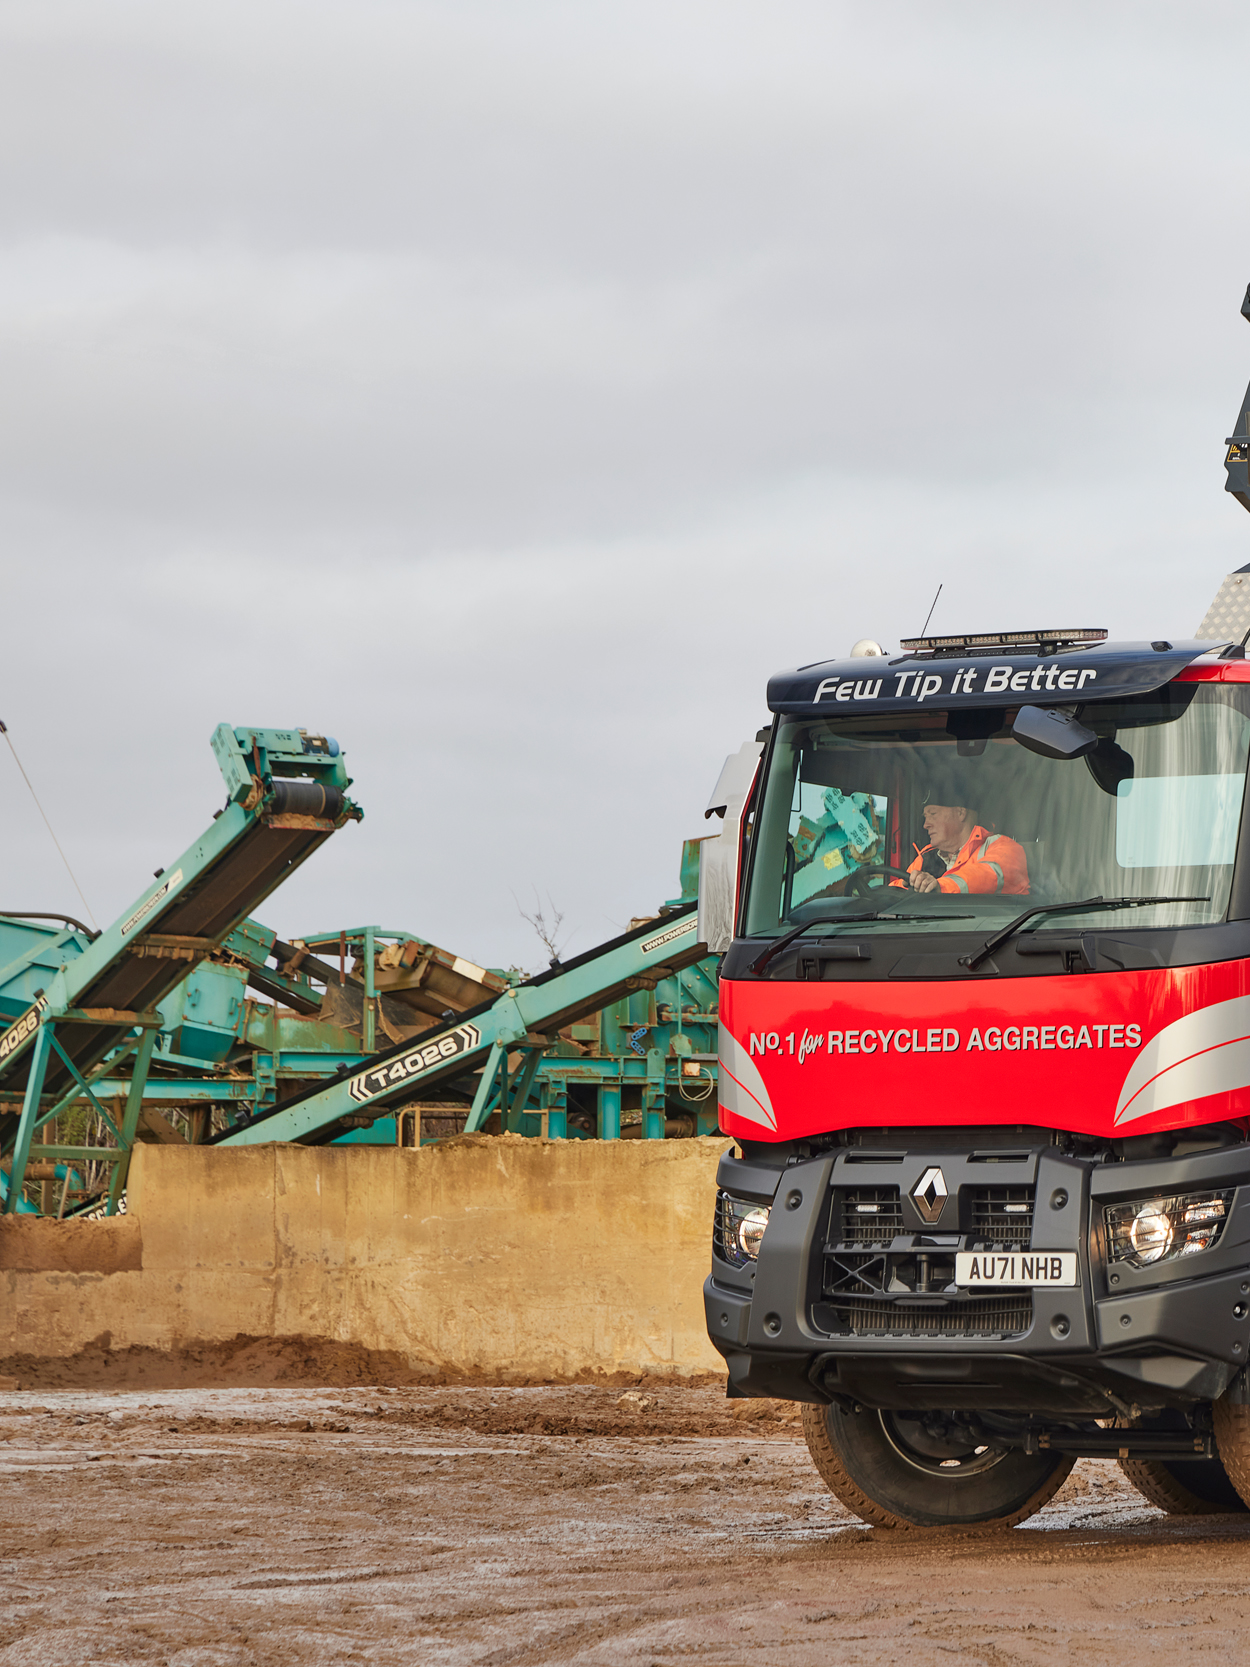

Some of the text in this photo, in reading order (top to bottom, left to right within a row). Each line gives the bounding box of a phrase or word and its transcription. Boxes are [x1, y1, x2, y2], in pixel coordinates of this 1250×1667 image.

[812, 664, 1097, 704] Few Tip it Better
[370, 1036, 458, 1088] T4026
[797, 1027, 825, 1065] for
[828, 1028, 961, 1055] RECYCLED
[966, 1023, 1142, 1052] AGGREGATES
[968, 1256, 1063, 1280] AU71 NHB
